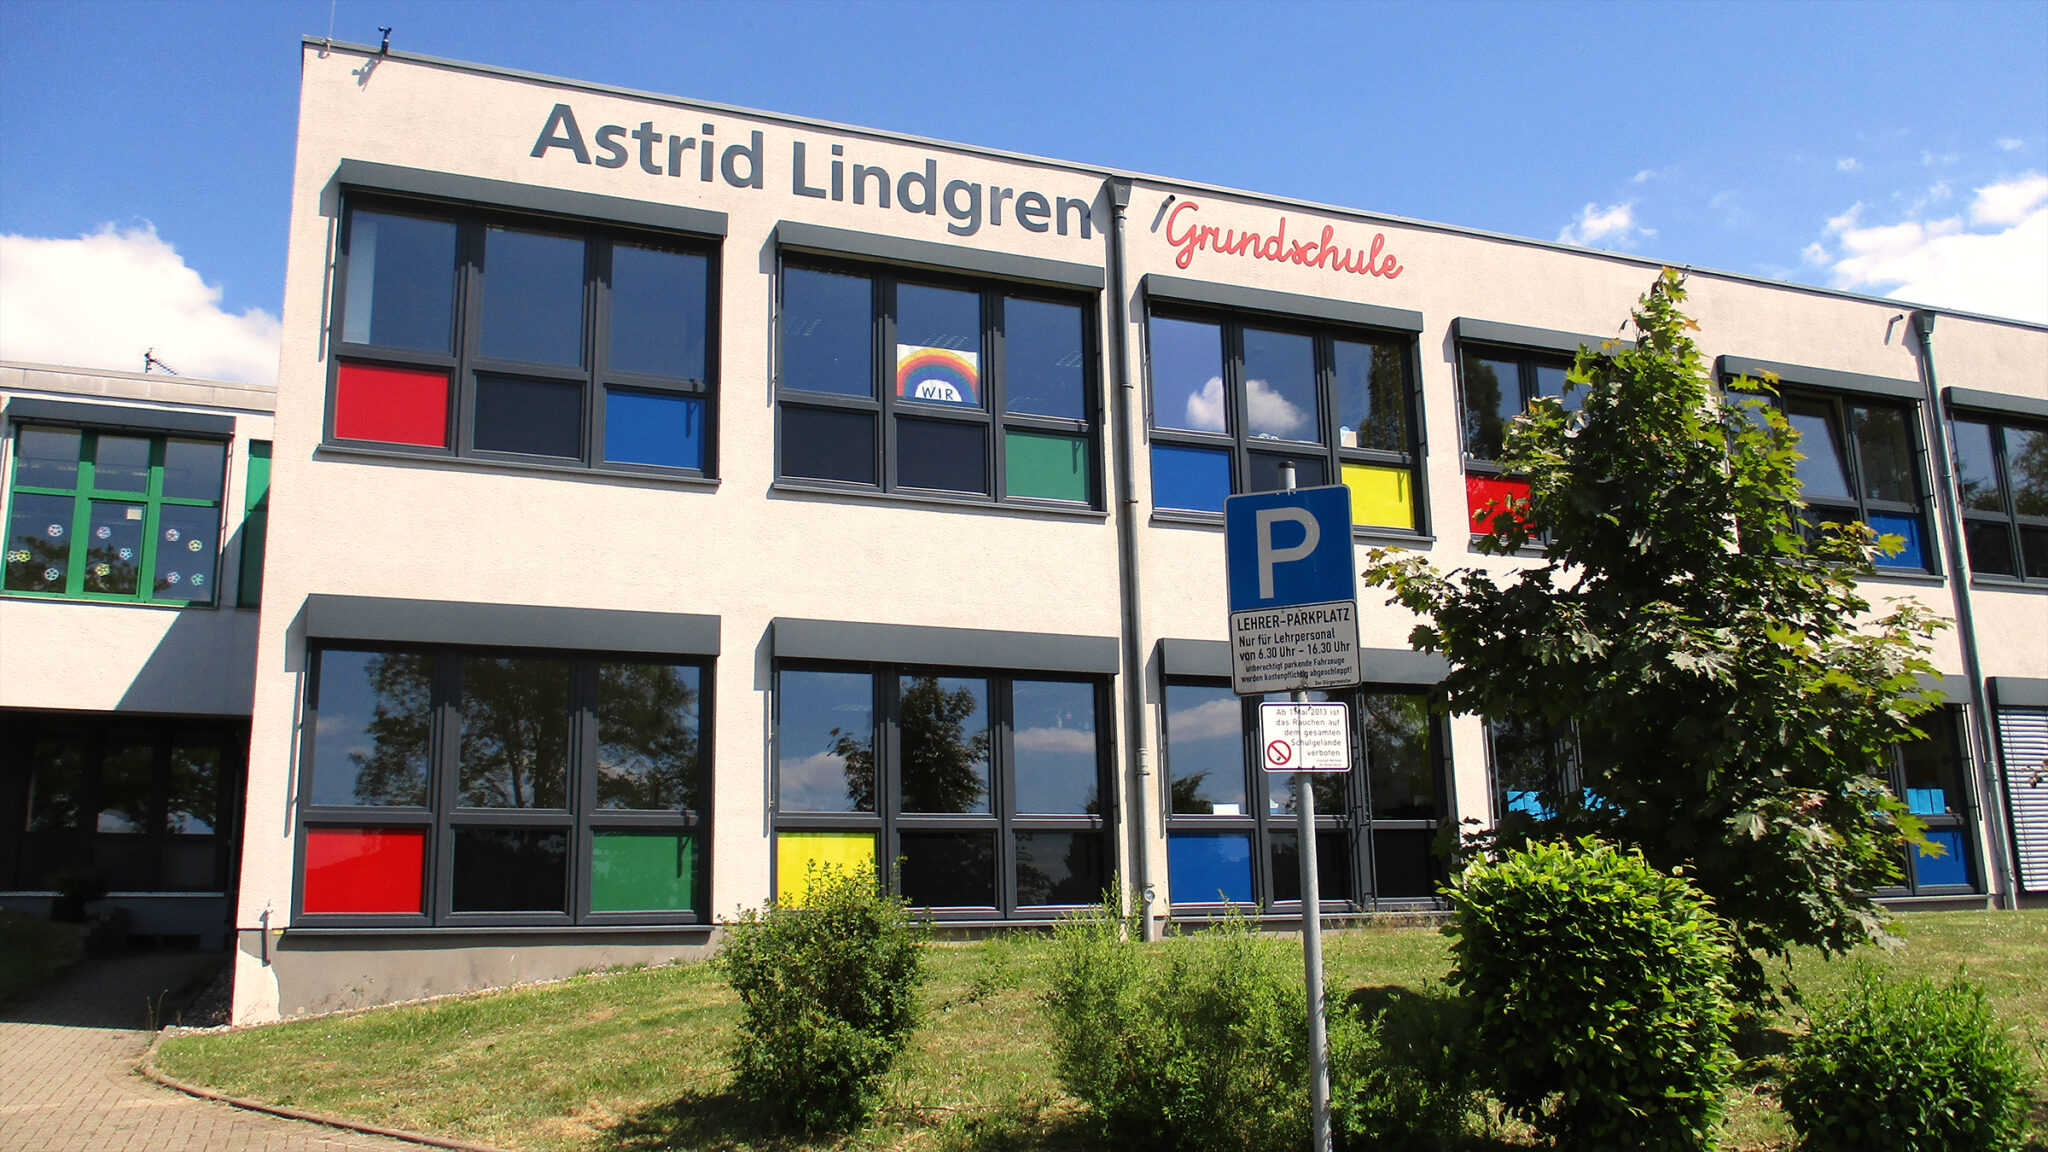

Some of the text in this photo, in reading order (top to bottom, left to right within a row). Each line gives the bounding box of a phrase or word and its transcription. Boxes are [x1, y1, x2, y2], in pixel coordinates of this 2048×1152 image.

[530, 103, 1092, 239] Astrid Lindgren
[1166, 201, 1403, 279] Grundschule
[922, 386, 953, 400] WIR
[1256, 507, 1320, 599] P
[1237, 608, 1350, 631] LEHRER-PARKPLATZ
[1239, 627, 1335, 647] Nur für Lehrpersonal
[1239, 652, 1256, 661] von
[1258, 647, 1277, 659] 6.30
[1280, 646, 1295, 657] Uhr
[1307, 643, 1332, 656] 16.30
[1334, 641, 1351, 652] Uhr
[1245, 657, 1345, 672] unberechtigt parkende Fahrzeuge
[1241, 666, 1353, 683] werden kostenpflichtig abgeschleppt!
[1276, 708, 1286, 716] Ab
[1310, 708, 1328, 716] 2013
[1330, 708, 1340, 716] ist
[1292, 718, 1325, 726] Rauchen
[1303, 729, 1341, 738] gesamten
